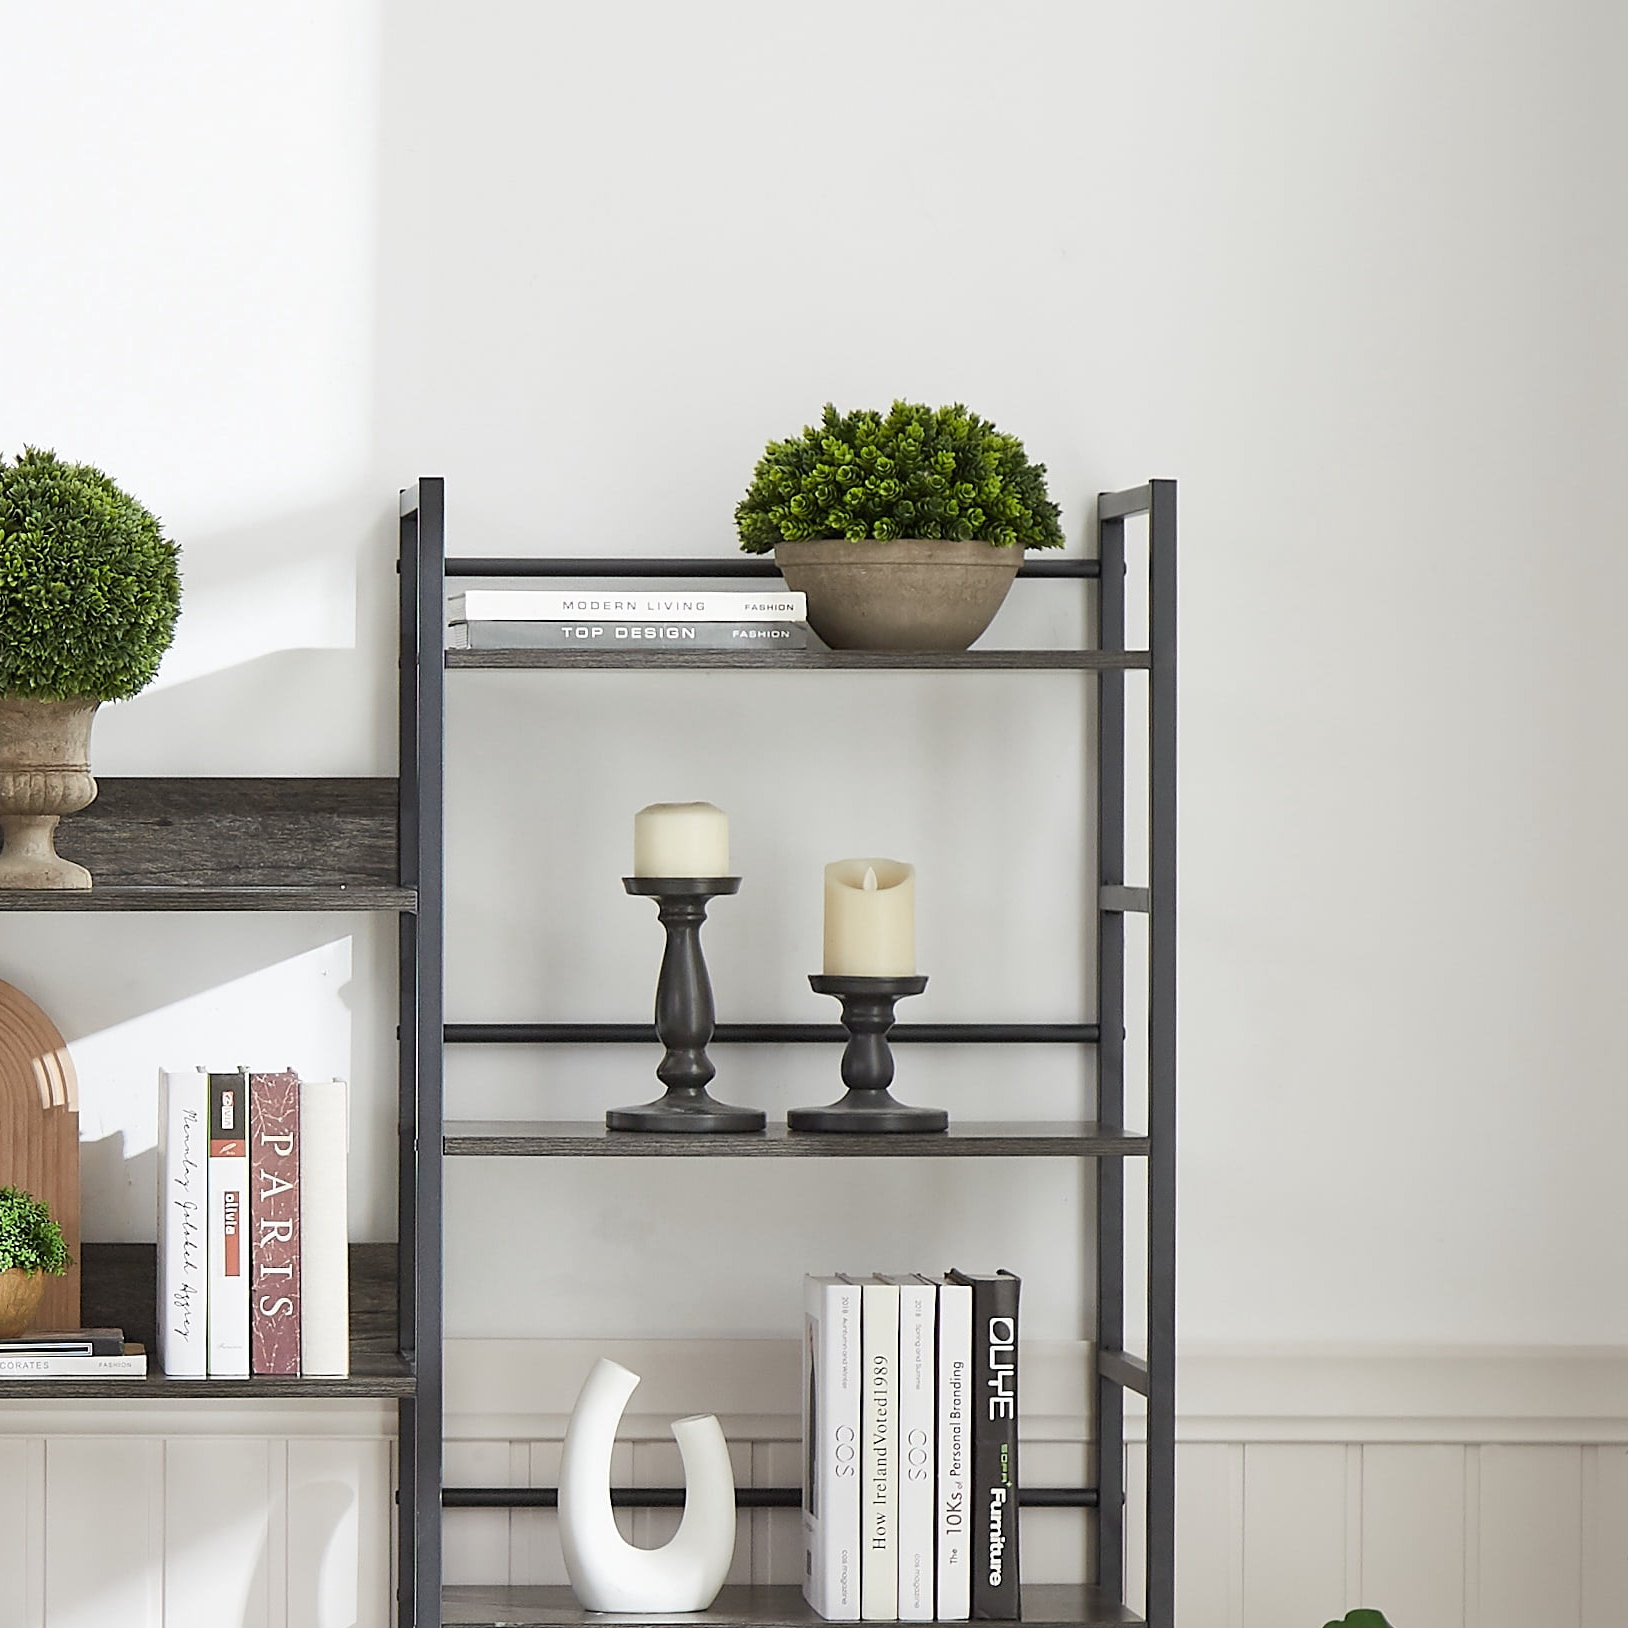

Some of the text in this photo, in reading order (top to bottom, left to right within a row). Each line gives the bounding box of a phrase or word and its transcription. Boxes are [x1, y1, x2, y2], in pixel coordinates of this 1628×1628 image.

[562, 601, 706, 611] MODERN LIVING
[744, 603, 794, 612] FASHION
[561, 627, 697, 639] TOP DESIGN
[732, 629, 790, 639] FASHION
[225, 1192, 239, 1235] olivia
[259, 1131, 294, 1317] PARIS
[949, 1361, 965, 1419] Branding
[836, 1425, 855, 1478] COS
[908, 1429, 927, 1481] COS
[949, 1422, 961, 1477] Personal
[872, 1511, 887, 1550] How
[946, 1492, 963, 1535] 10Ks
[949, 1548, 958, 1564] The
[988, 1487, 1007, 1587] Furniture
[840, 1565, 849, 1605] magazine
[912, 1569, 921, 1609] magazine
